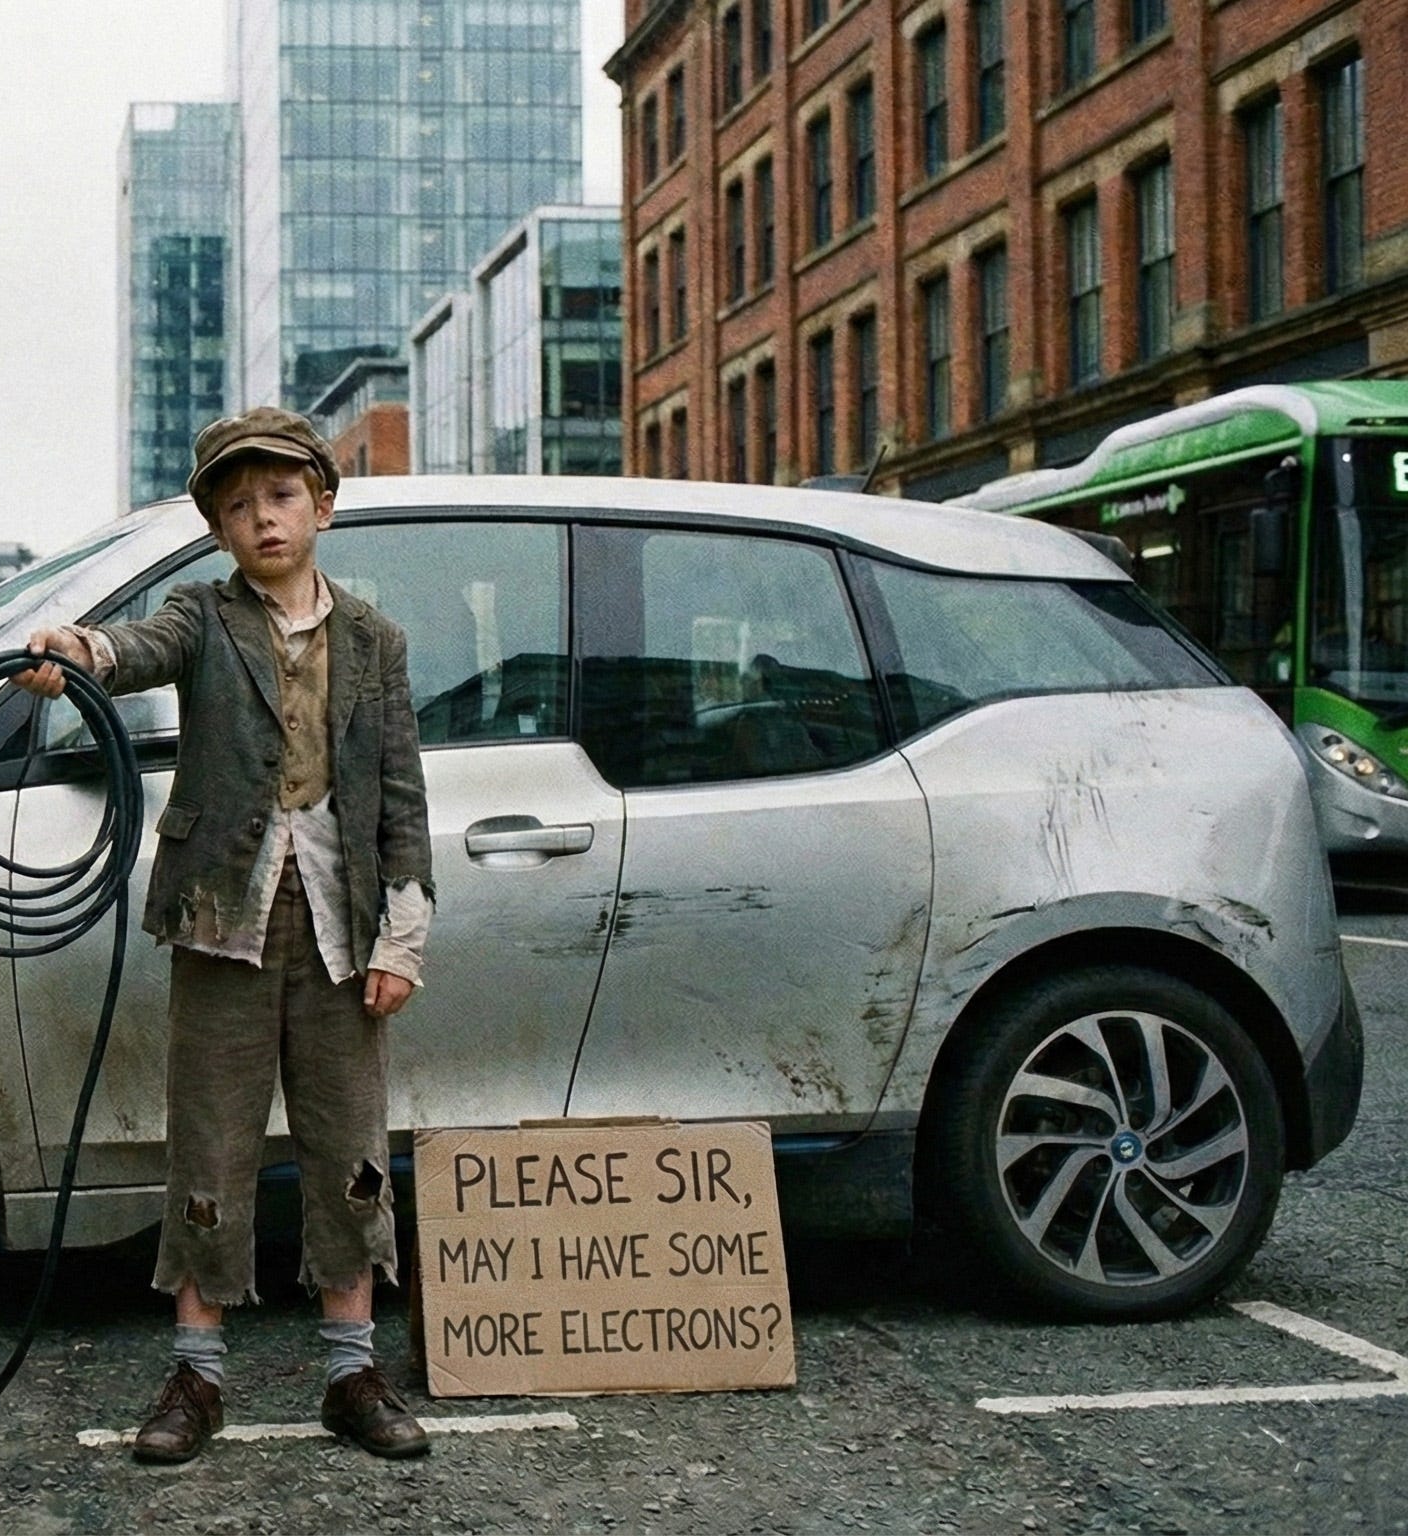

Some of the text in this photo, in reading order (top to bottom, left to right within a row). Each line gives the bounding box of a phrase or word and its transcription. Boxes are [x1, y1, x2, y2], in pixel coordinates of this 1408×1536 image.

[454, 1147, 752, 1213] PLEASE SIR,
[438, 1230, 769, 1284] MAY I HAVE SOME
[443, 1302, 782, 1358] MORE ELECTRONS?
